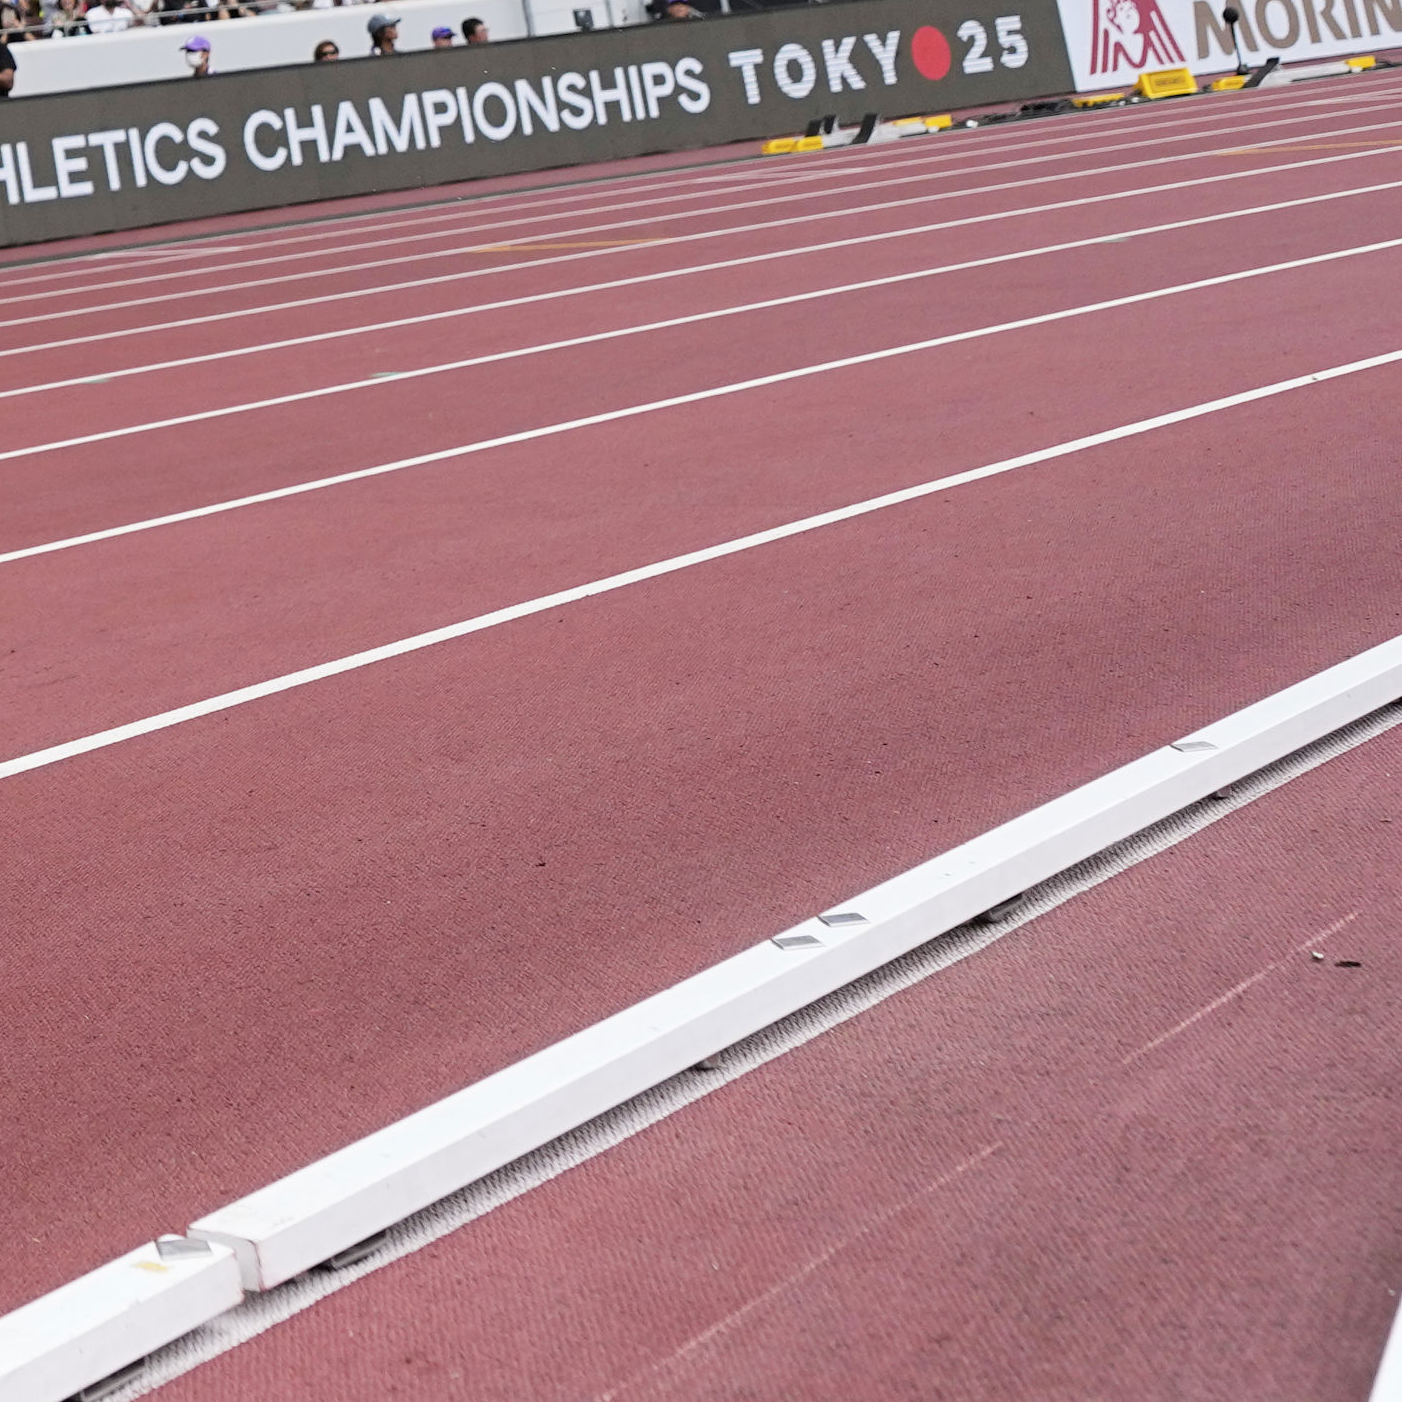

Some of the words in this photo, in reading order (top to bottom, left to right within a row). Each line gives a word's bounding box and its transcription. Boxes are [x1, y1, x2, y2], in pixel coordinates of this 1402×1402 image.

[242, 55, 710, 172] CHAMPIONSHIPS
[728, 24, 953, 105] TOKYO
[960, 14, 1030, 74] 25
